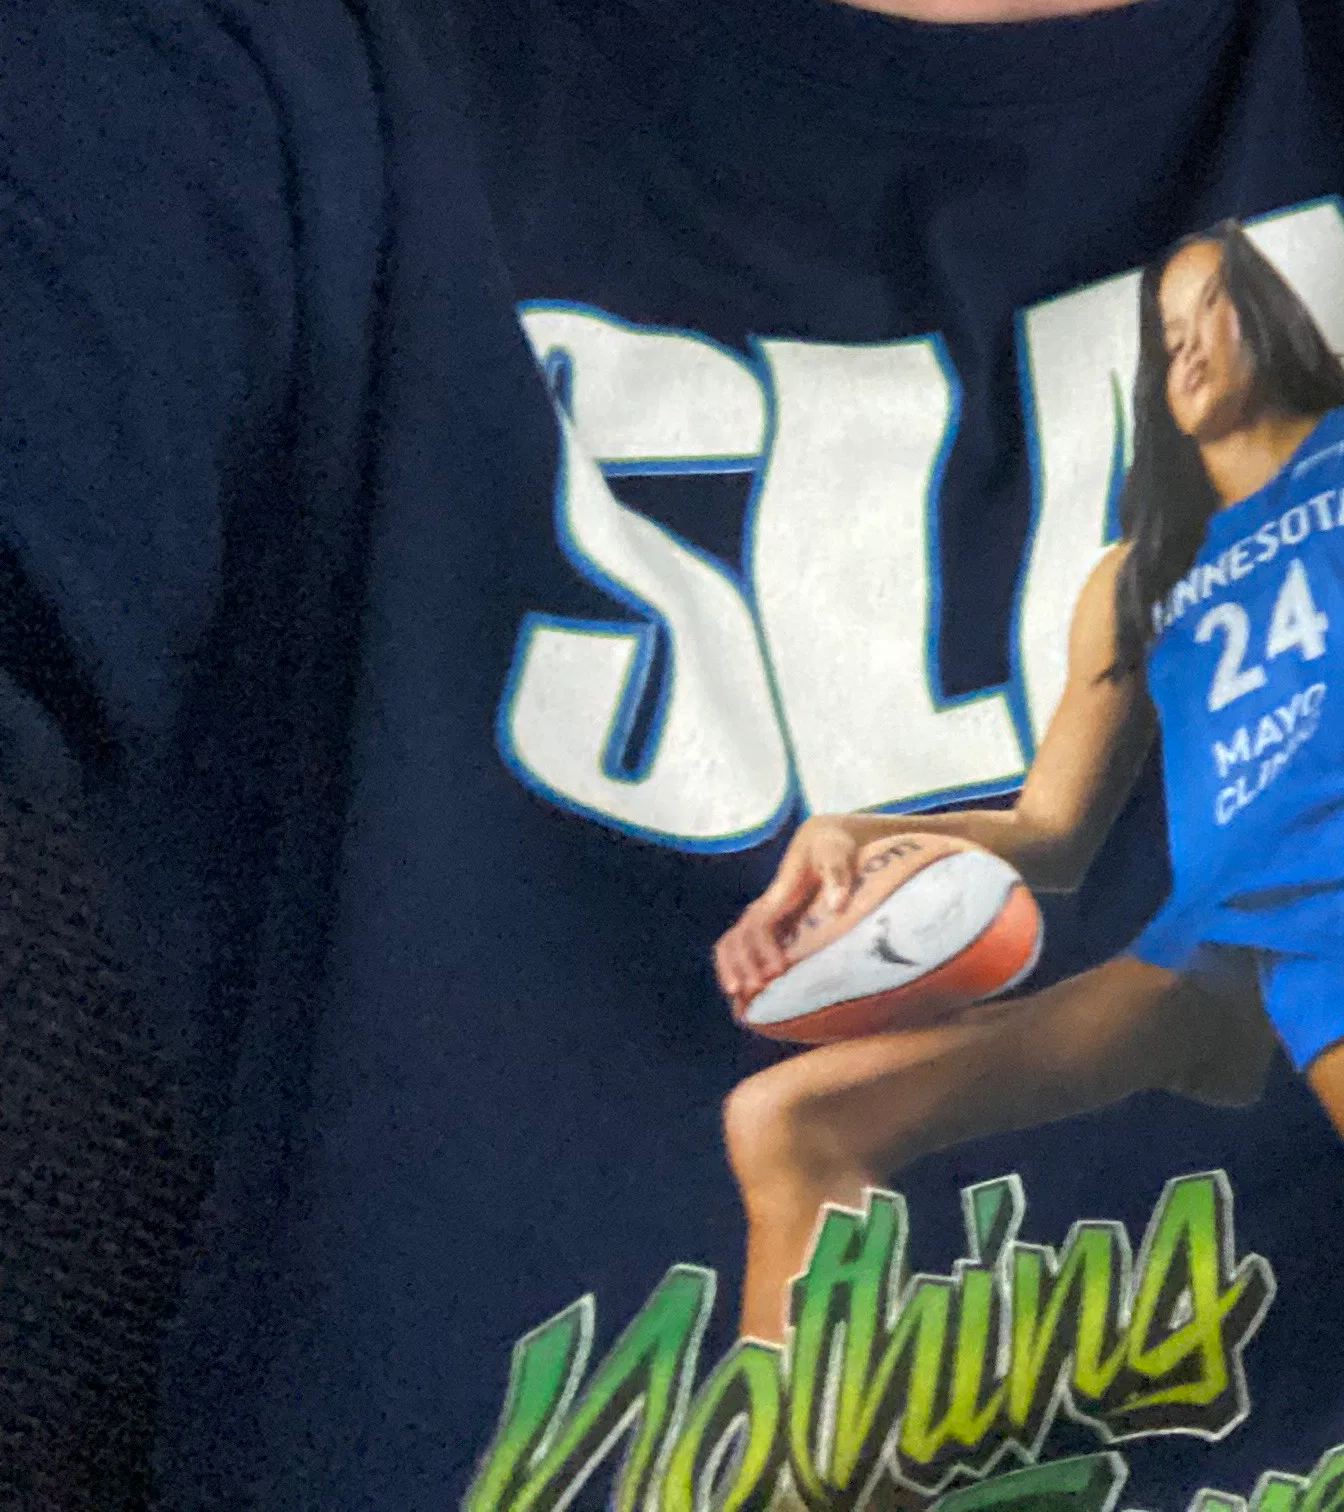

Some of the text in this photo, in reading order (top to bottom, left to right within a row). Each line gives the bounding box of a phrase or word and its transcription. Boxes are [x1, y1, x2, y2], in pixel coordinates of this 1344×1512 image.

[1194, 557, 1330, 714] 24
[1211, 681, 1329, 780] MAYO
[458, 1168, 1278, 1512] Nothing
